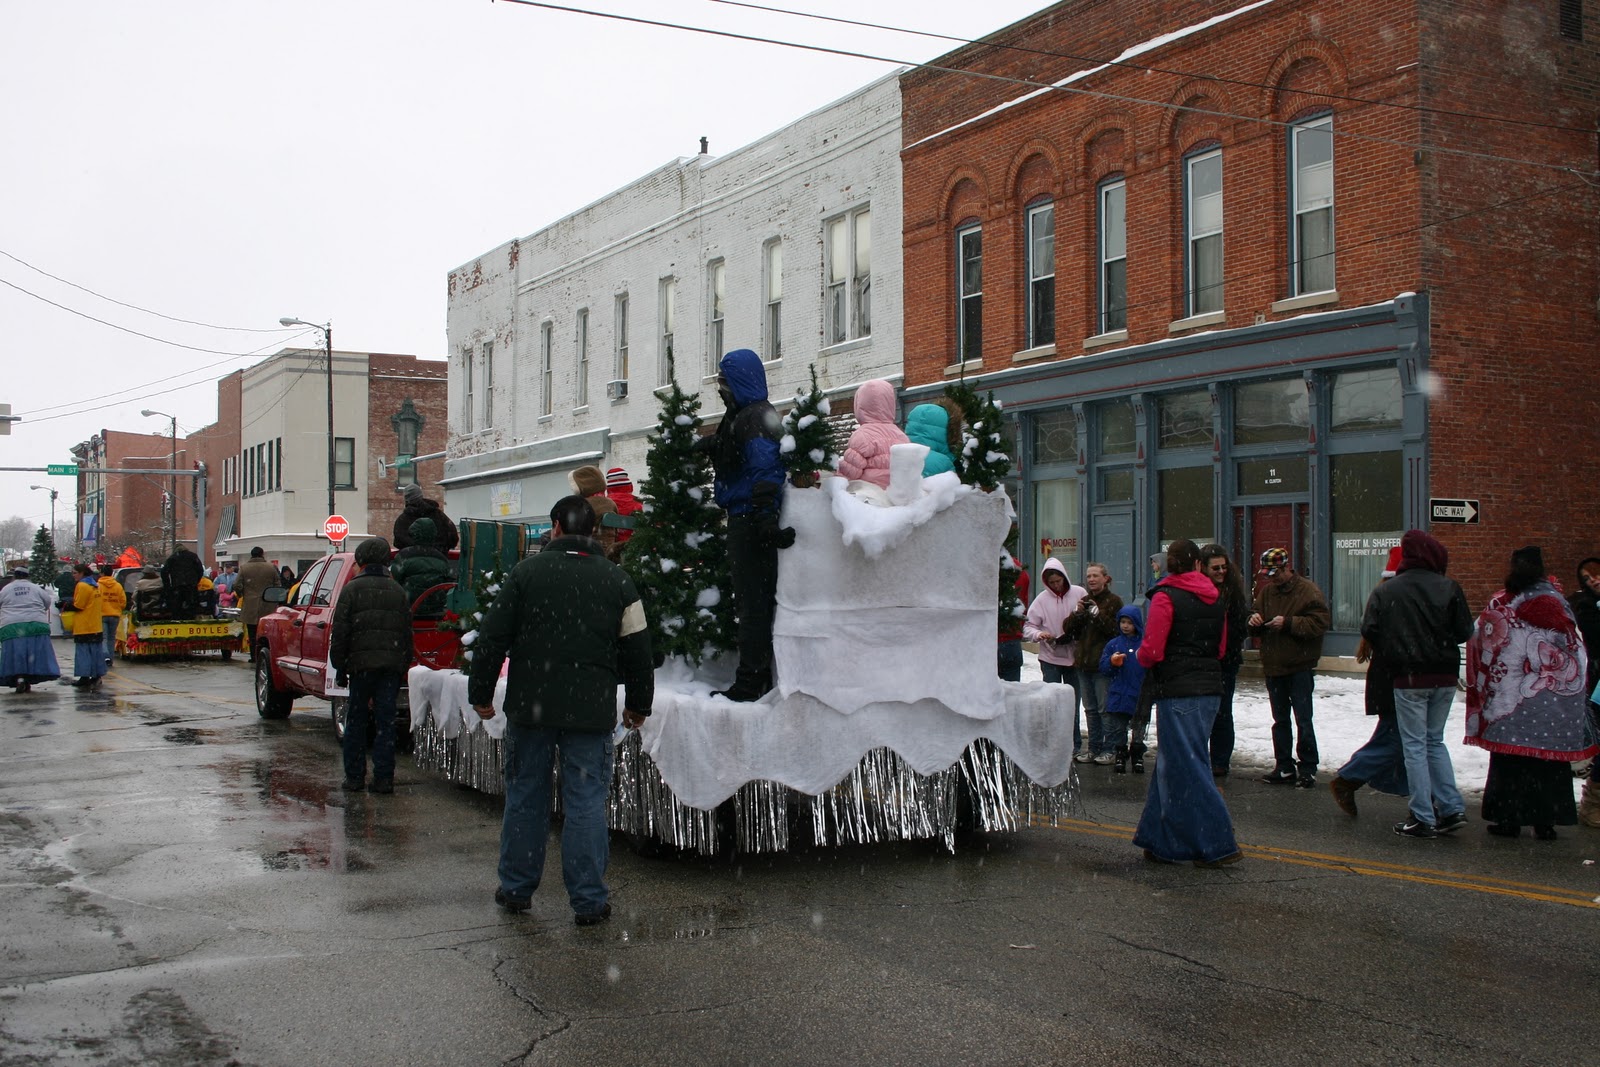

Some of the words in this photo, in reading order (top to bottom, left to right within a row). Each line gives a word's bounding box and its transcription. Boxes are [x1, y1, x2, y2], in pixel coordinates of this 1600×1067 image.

[1435, 507, 1448, 516] ONE
[1451, 508, 1464, 516] WAY
[326, 523, 347, 533] STOP
[1052, 538, 1076, 547] MOORE
[1336, 540, 1361, 548] ROBERT
[1372, 538, 1402, 548] SHAFFER
[189, 626, 229, 634] BOYLES
